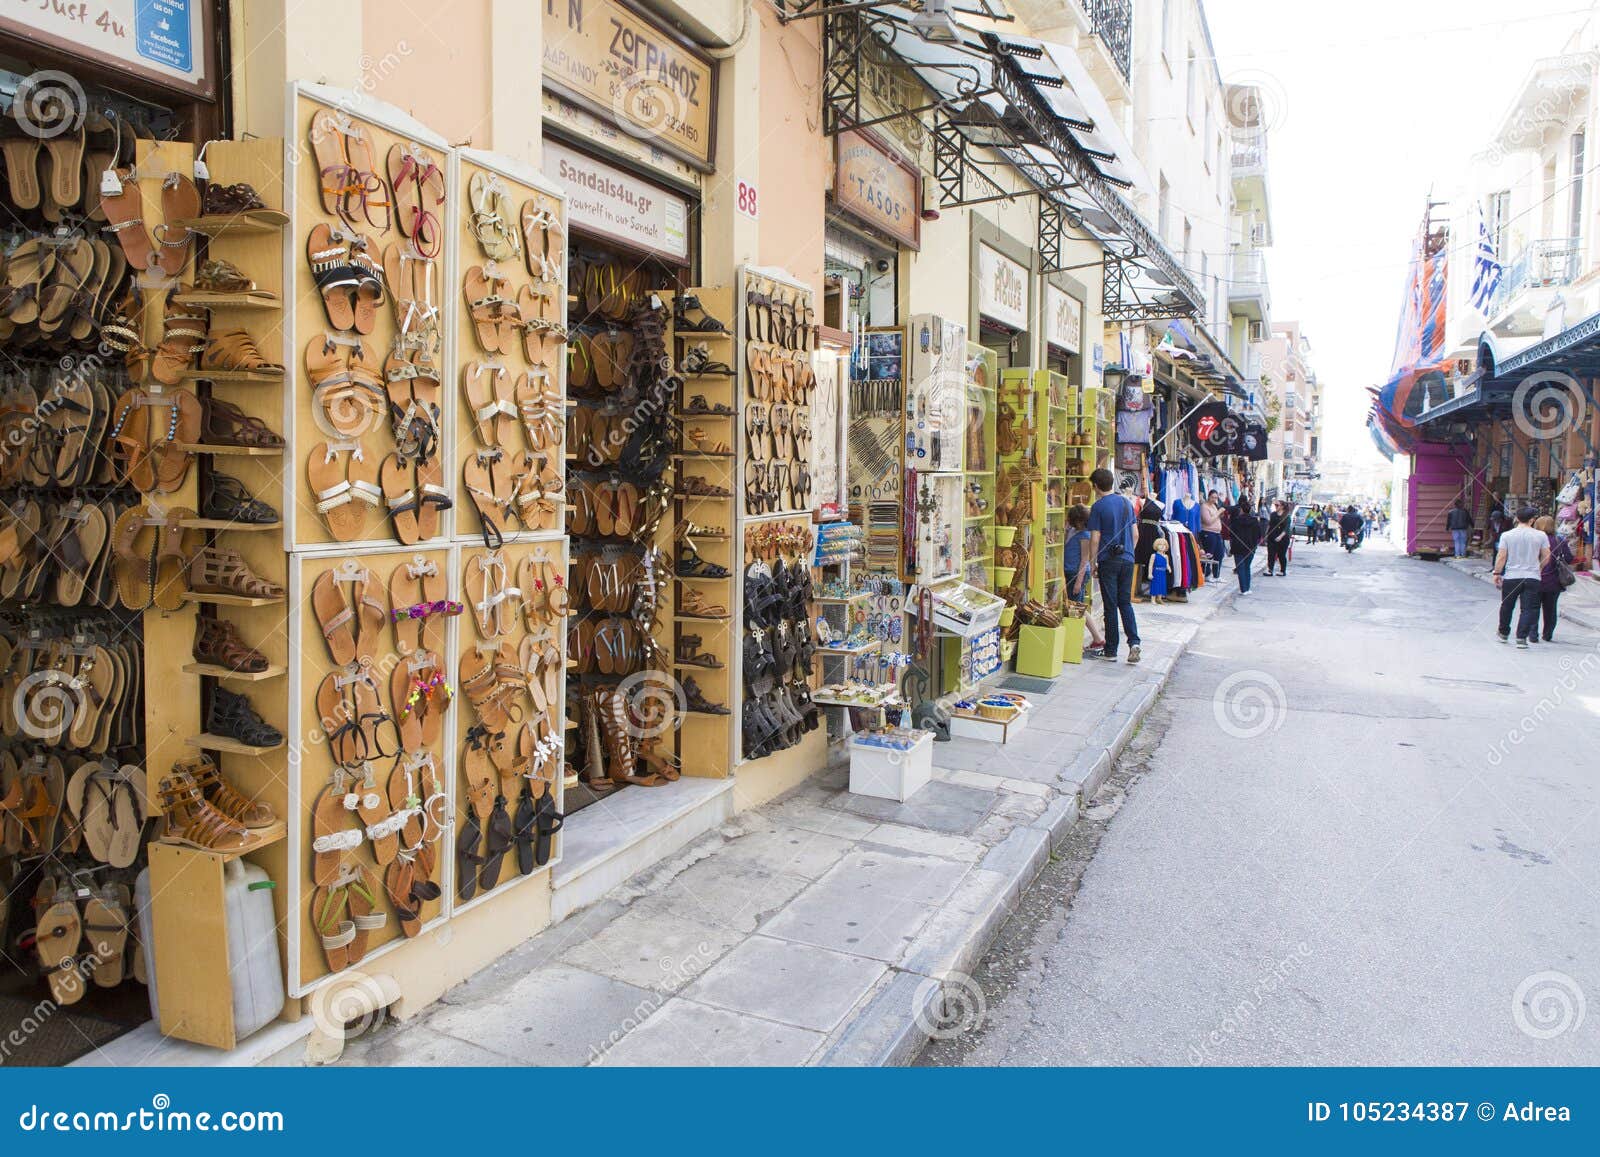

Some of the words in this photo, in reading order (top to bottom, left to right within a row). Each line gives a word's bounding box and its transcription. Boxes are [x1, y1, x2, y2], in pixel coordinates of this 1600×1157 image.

[96, 11, 125, 38] 4u
[559, 158, 653, 215] Sandals4u.gr
[738, 181, 757, 216] 88
